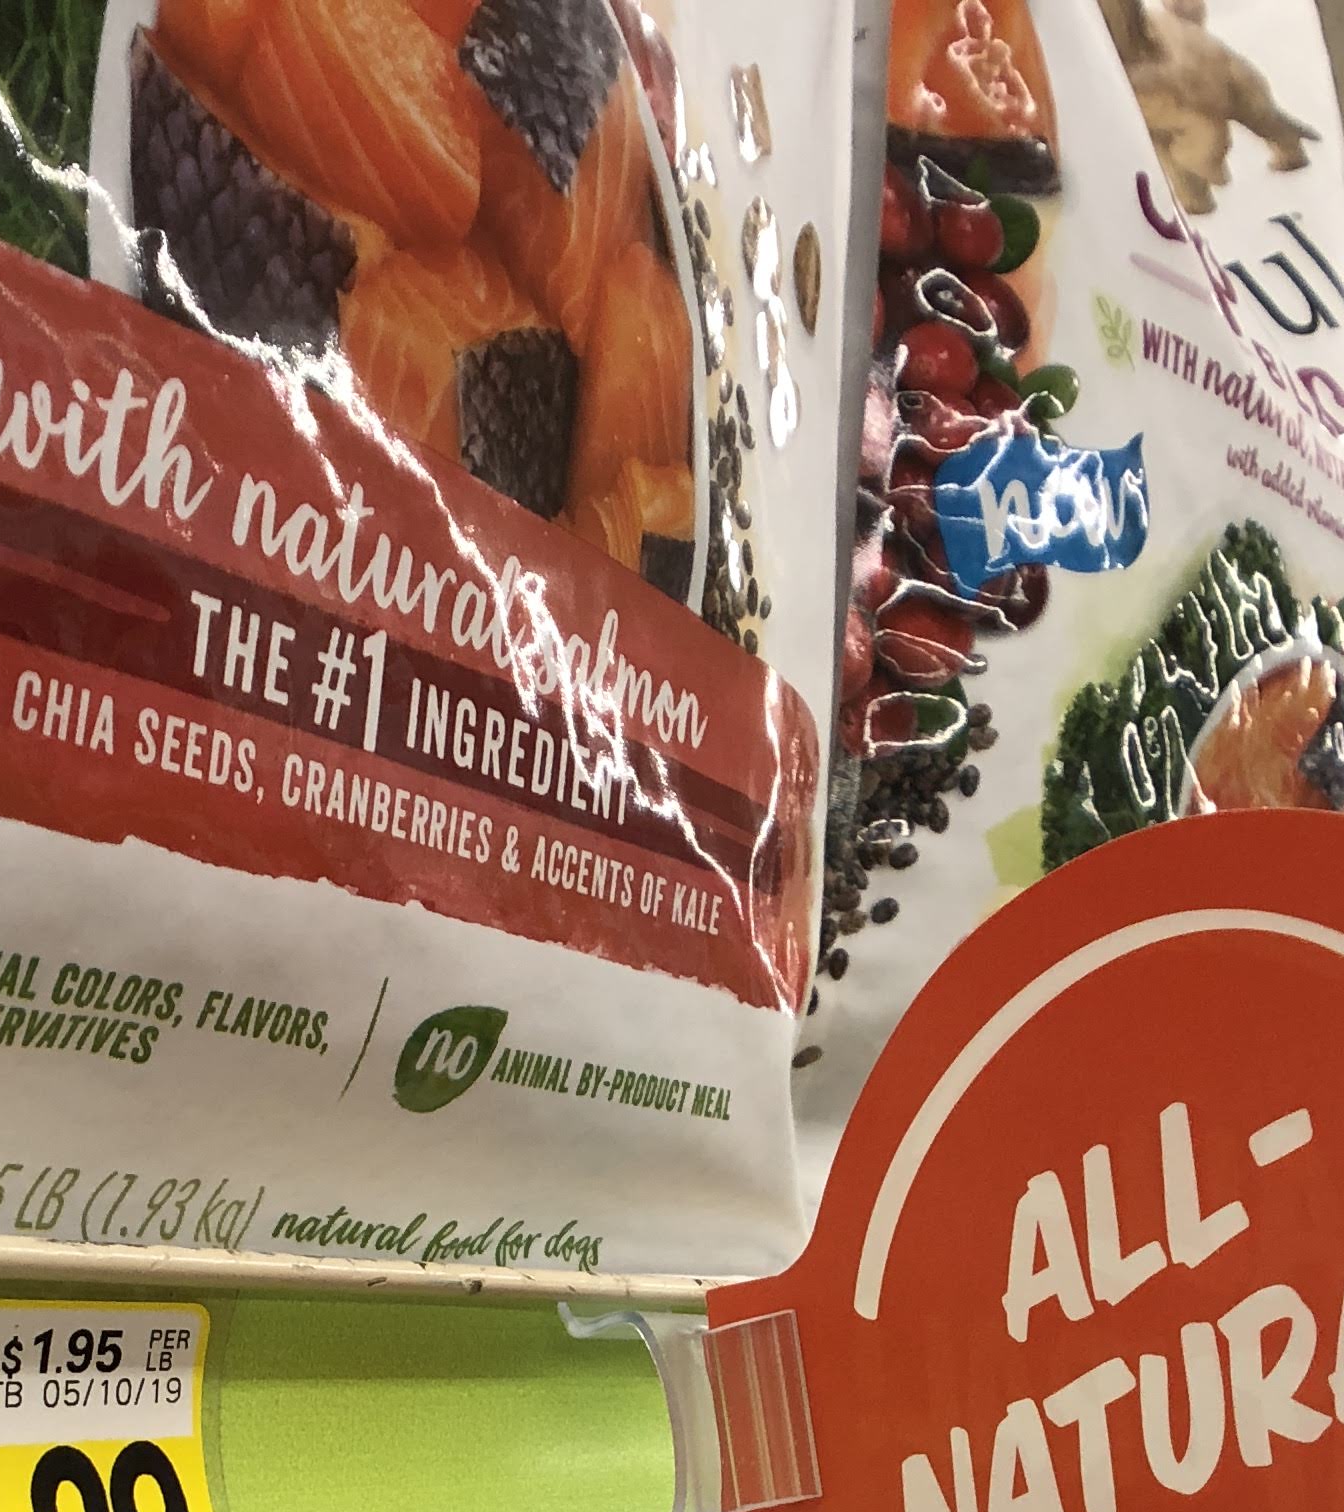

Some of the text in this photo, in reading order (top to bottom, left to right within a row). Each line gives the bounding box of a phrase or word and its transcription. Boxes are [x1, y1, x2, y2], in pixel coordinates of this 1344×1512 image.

[1142, 319, 1198, 384] WITH
[231, 473, 533, 670] natural
[191, 590, 631, 825] THE #1 INGREDIENT
[12, 670, 114, 755] CHIA
[134, 708, 264, 802] SEEDS,
[282, 753, 492, 864] CRANBERRIES
[501, 825, 522, 874] &
[531, 836, 633, 910] ACCENTS
[639, 868, 667, 919] OF
[671, 883, 724, 937] KALE
[51, 963, 186, 1030] COLORS,
[197, 989, 331, 1055] FLAVORS,
[415, 1026, 479, 1081] no
[490, 1047, 732, 1121] ANIMAL BY-PRODUCT MEAL
[14, 1167, 81, 1232] LB
[80, 1171, 203, 1243] (1.93
[193, 1179, 265, 1252] kg)
[271, 1206, 604, 1272] natural food for dogs
[1001, 1102, 1313, 1343] ALL-
[0, 1328, 124, 1379] $1.95
[145, 1351, 174, 1372] LB
[148, 1329, 192, 1350] PER
[42, 1378, 182, 1408] 05/10/19
